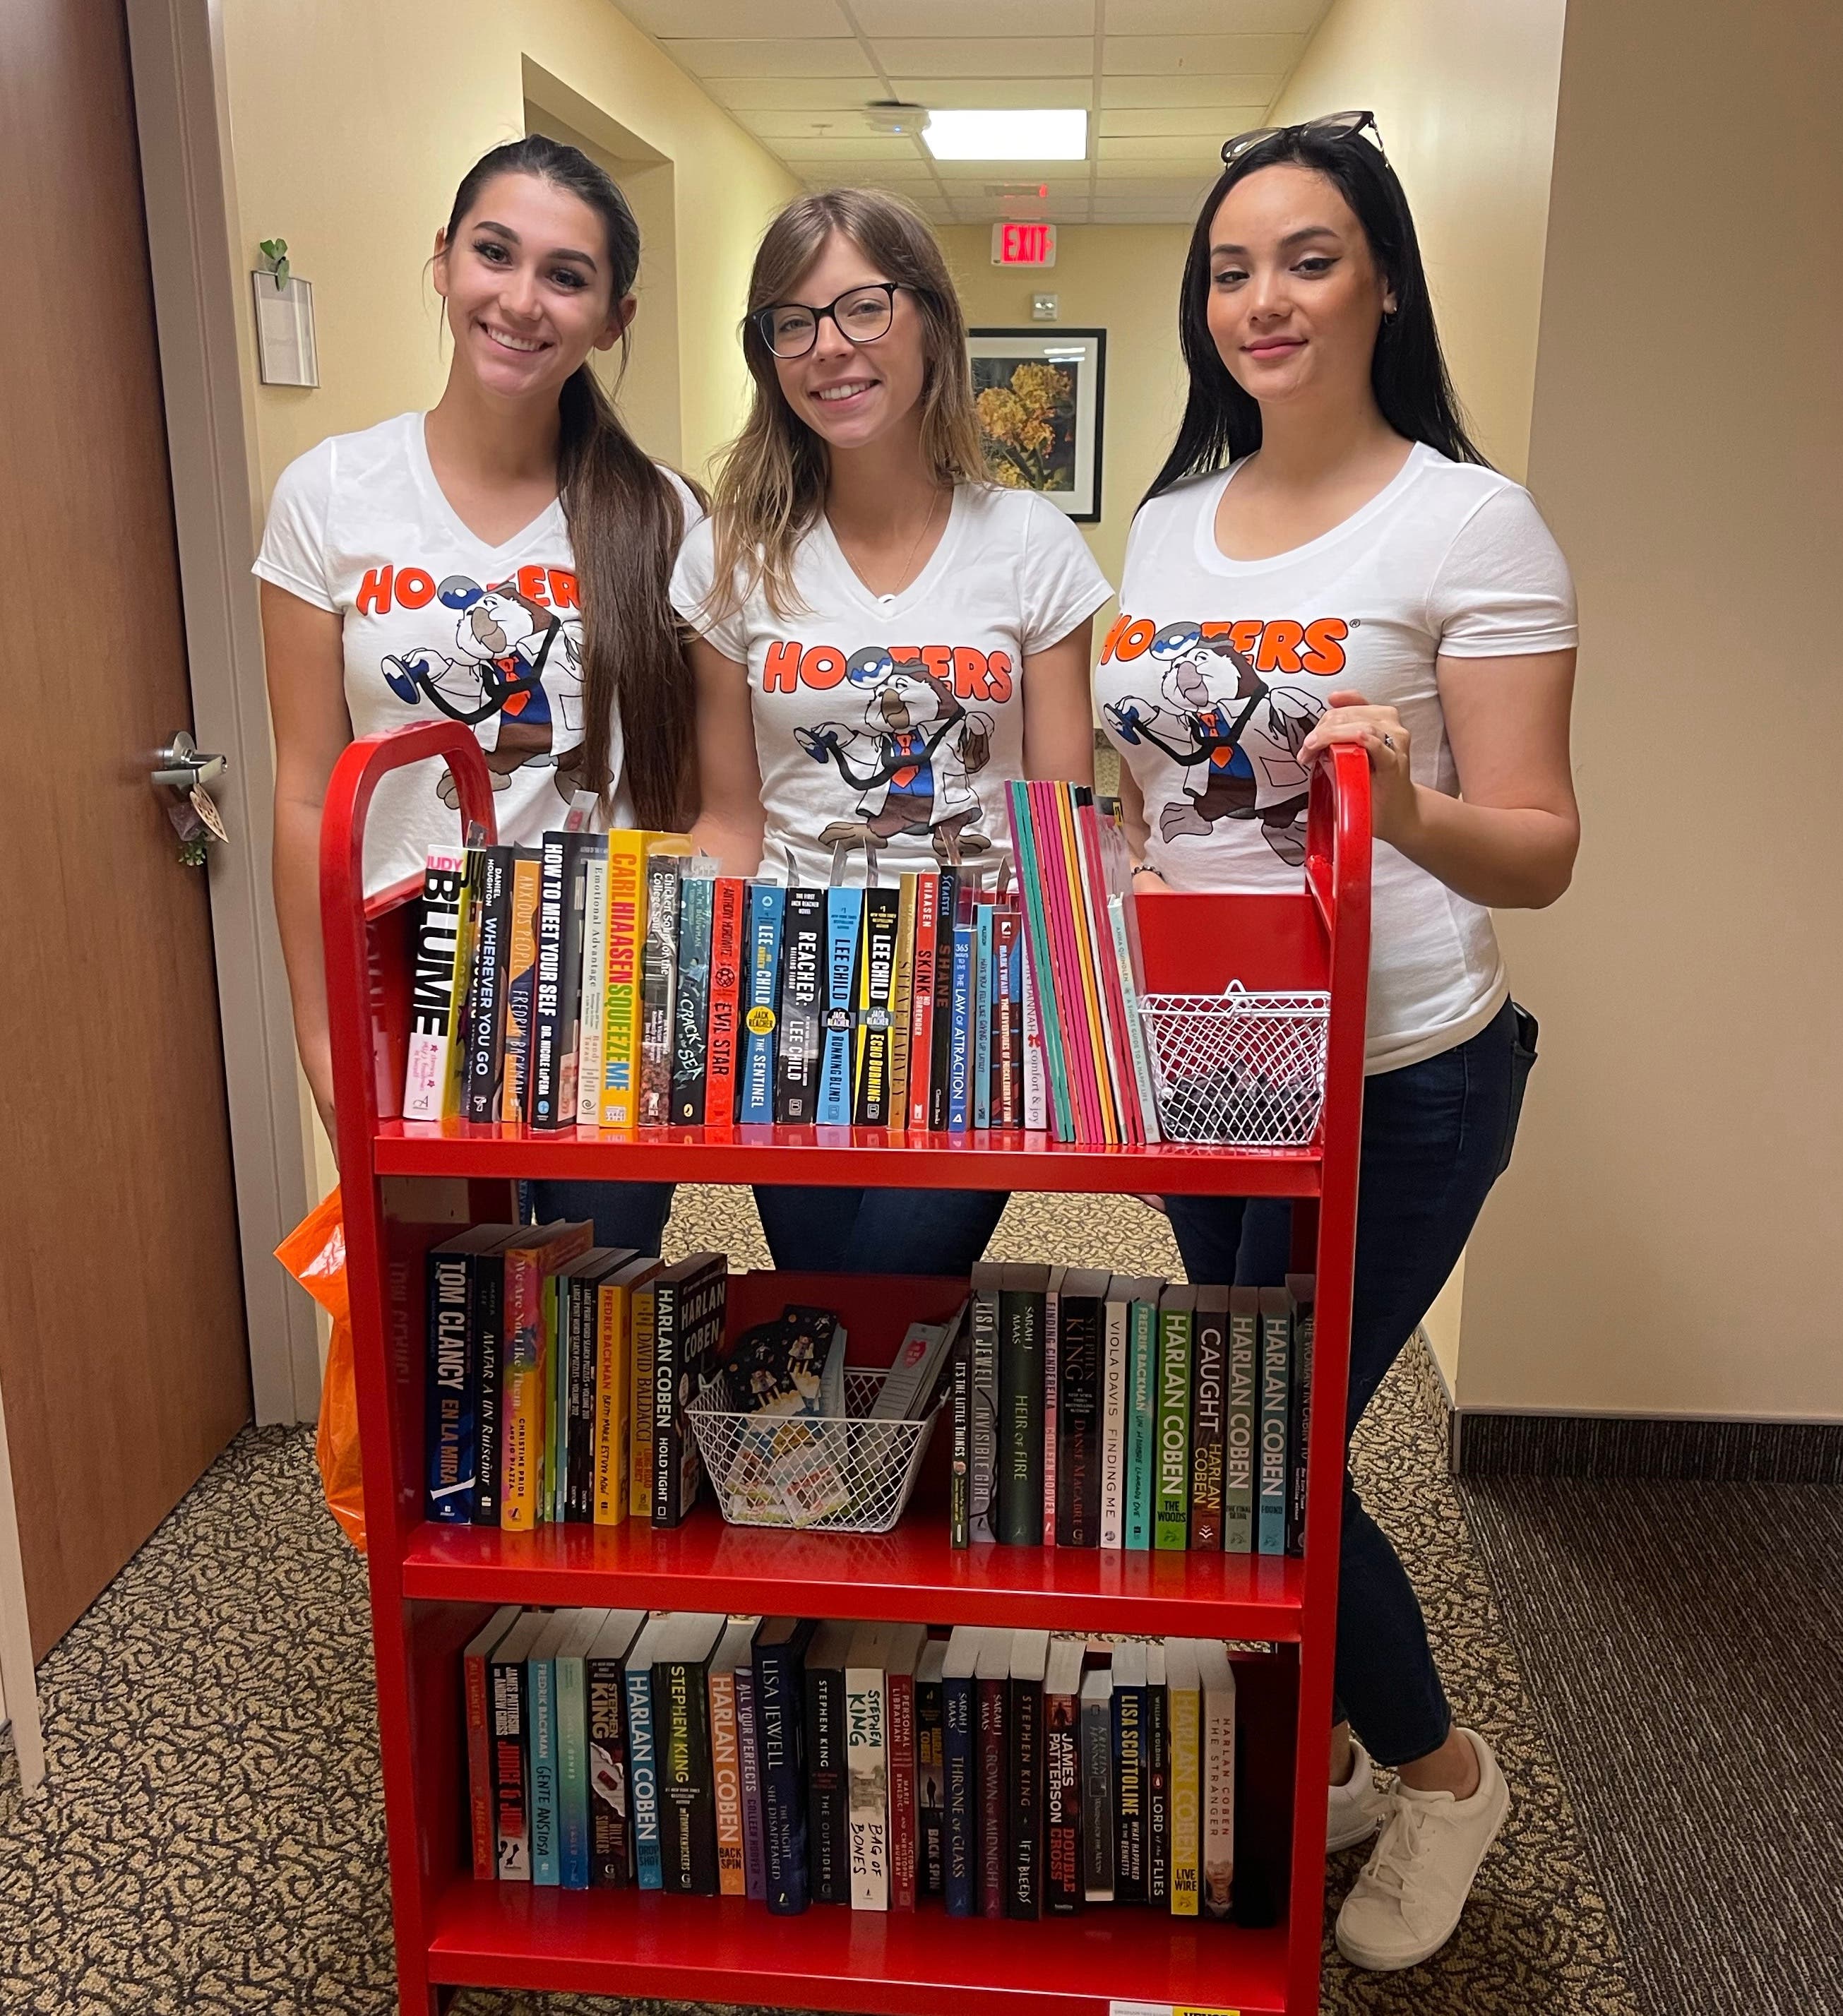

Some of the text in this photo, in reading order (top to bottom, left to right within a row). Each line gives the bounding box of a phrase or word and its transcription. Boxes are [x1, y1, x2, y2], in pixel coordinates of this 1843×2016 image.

[1002, 224, 1049, 263] EXIT
[357, 564, 583, 616] HOOER
[426, 856, 463, 871] JUDY
[485, 858, 495, 907] HOUGHTON
[494, 867, 502, 899] DANIEL
[651, 873, 662, 908] College
[923, 882, 933, 927] HIAASEN
[412, 870, 462, 1037] BLUME
[538, 842, 563, 1018] HOW TO MEET YOUR SELF
[758, 925, 773, 945] LEE
[835, 938, 850, 962] LEE
[873, 934, 891, 960] LEE
[588, 929, 601, 986] Advantage
[604, 853, 636, 1092] CARL HIAASEN SQUEEZE ME
[796, 931, 816, 1006] REACHER:
[833, 965, 849, 1000] CHILD
[871, 961, 890, 999] CHILD
[916, 950, 931, 996] SKINK
[936, 944, 951, 1008] SHANE
[475, 917, 497, 1075] WHEREVER YOU GO
[755, 970, 771, 1003] CHILD
[923, 996, 931, 1006] NO
[955, 989, 966, 1015] LAW
[541, 1025, 551, 1039] DR.
[712, 1003, 732, 1075] EVIL STAR
[748, 1018, 773, 1027] REACHER
[754, 1010, 769, 1019] JACK
[828, 1018, 849, 1027] REACHER
[867, 1017, 888, 1025] REACHER
[914, 995, 923, 1036] SURRENDER
[539, 1040, 551, 1067] NICOLE
[751, 1038, 765, 1109] THE SENTINEL
[787, 1020, 804, 1081] LEE CHILD
[867, 1034, 884, 1103] ECHO BURNING
[953, 1027, 965, 1109] ATTRACTION
[1031, 1049, 1042, 1091] comfort
[1029, 1107, 1039, 1124] joy
[572, 1284, 580, 1301] LARGE
[681, 1280, 726, 1331] HARLAN
[436, 1261, 465, 1390] TOM CLANCY
[572, 1336, 580, 1354] SEARCH
[684, 1318, 720, 1364] COBEN
[974, 1302, 993, 1390] LISA JEWELL
[1065, 1318, 1085, 1383] KING
[572, 1356, 580, 1378] PUZZLES
[636, 1332, 652, 1373] DAVID
[655, 1289, 674, 1428] HARLAN COBEN
[955, 1380, 965, 1398] THE
[1162, 1315, 1187, 1495] HARLAN COBEN
[1200, 1328, 1221, 1433] CAUGHT
[1229, 1317, 1254, 1489] HARLAN COBEN
[636, 1375, 652, 1443] BALDACCI
[955, 1399, 965, 1430] LITTLE
[1105, 1320, 1120, 1519] VIOLA DAVIS FINDING ME
[1262, 1318, 1287, 1497] HARLAN COBEN
[440, 1400, 459, 1484] EN LA MIRA
[955, 1431, 965, 1457] THINGS
[657, 1438, 669, 1502] HOLD TIGHT
[1193, 1448, 1207, 1504] COBEN
[1207, 1443, 1222, 1510] HARLAN
[1157, 1511, 1186, 1522] WOODS
[1164, 1501, 1179, 1512] THE
[590, 1682, 610, 1739] KING
[607, 1683, 619, 1739] STEPHEN
[672, 1666, 688, 1738] STEPHEN
[762, 1659, 784, 1771] LISA JEWELL
[818, 1680, 829, 1767] STEPHEN KING
[847, 1693, 867, 1747] KING
[868, 1690, 882, 1748] STEPHEN
[901, 1695, 912, 1748] PERSONAL
[628, 1676, 657, 1840] HARLAN COBEN
[674, 1743, 689, 1784] KING
[712, 1676, 739, 1843] HARLAN COBEN
[1021, 1695, 1032, 1808] STEPHEN KING
[1061, 1733, 1074, 1788] JAMES
[1121, 1695, 1139, 1817] LISA SCOTTOLINE
[1209, 1718, 1220, 1837] THE STRANGER
[1222, 1717, 1231, 1837] HARLAN COBEN
[1049, 1733, 1062, 1824] PATTERSON
[537, 1765, 551, 1856] GENTE ANSIOSA
[1153, 1796, 1164, 1833] LORD
[720, 1847, 741, 1859] BACK
[720, 1858, 741, 1870] SPIN
[767, 1808, 780, 1880] DISAPPEARED
[781, 1824, 792, 1860] NIGHT
[821, 1818, 830, 1880] OUTSIDER
[850, 1822, 866, 1875] BONES
[869, 1823, 883, 1878] BAG OF
[1050, 1827, 1063, 1881] CROSS
[1063, 1827, 1075, 1894] DOUBLE
[1131, 1845, 1140, 1880] HAPPENED
[1153, 1859, 1164, 1897] FLIES
[1174, 1880, 1197, 1892] WIRE
[1176, 1868, 1196, 1880] LIVE
